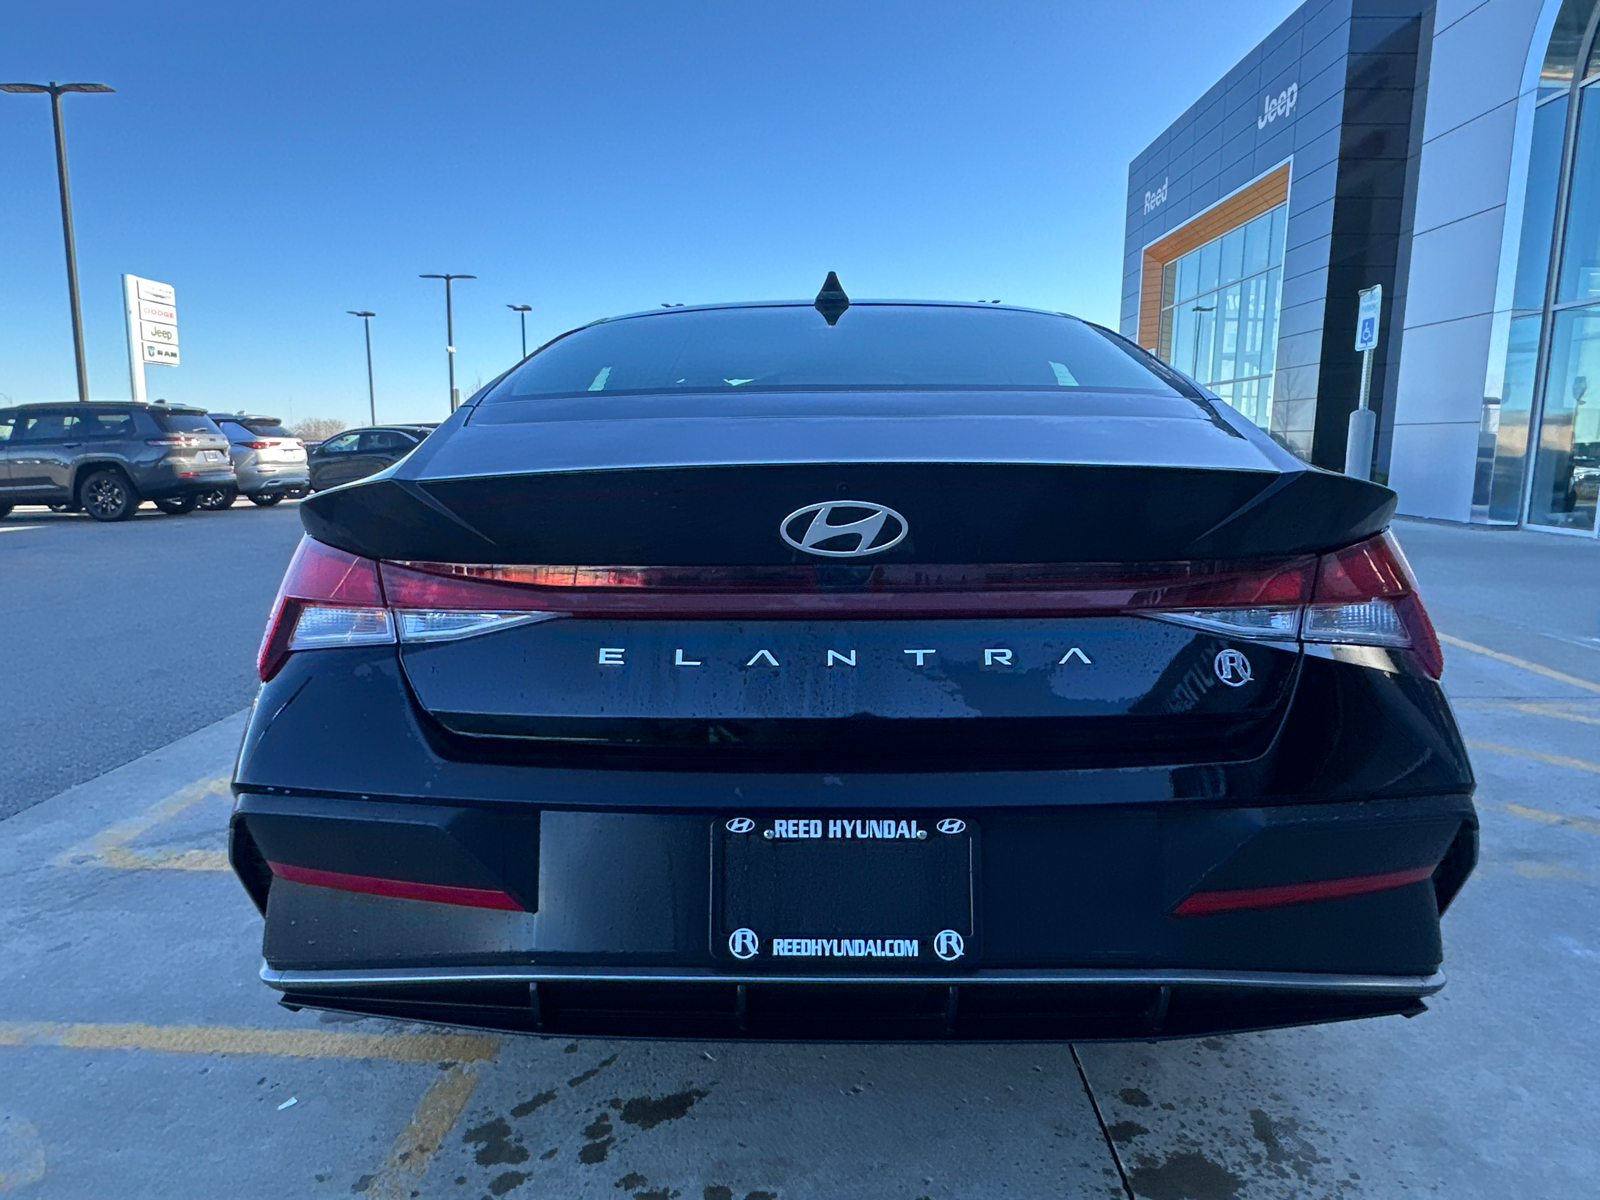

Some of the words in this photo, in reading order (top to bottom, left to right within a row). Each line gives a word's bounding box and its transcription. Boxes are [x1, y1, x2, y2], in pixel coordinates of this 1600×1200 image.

[1257, 82, 1298, 130] Jeep
[1143, 176, 1169, 216] Reed
[143, 307, 174, 318] DODGE
[151, 326, 172, 341] Jeep
[157, 349, 177, 358] RAM
[598, 647, 1092, 666] ELANTRA
[774, 819, 822, 838] REED
[828, 820, 917, 839] HYUNDAI
[772, 938, 919, 957] REEDHYUNDAI.COM
